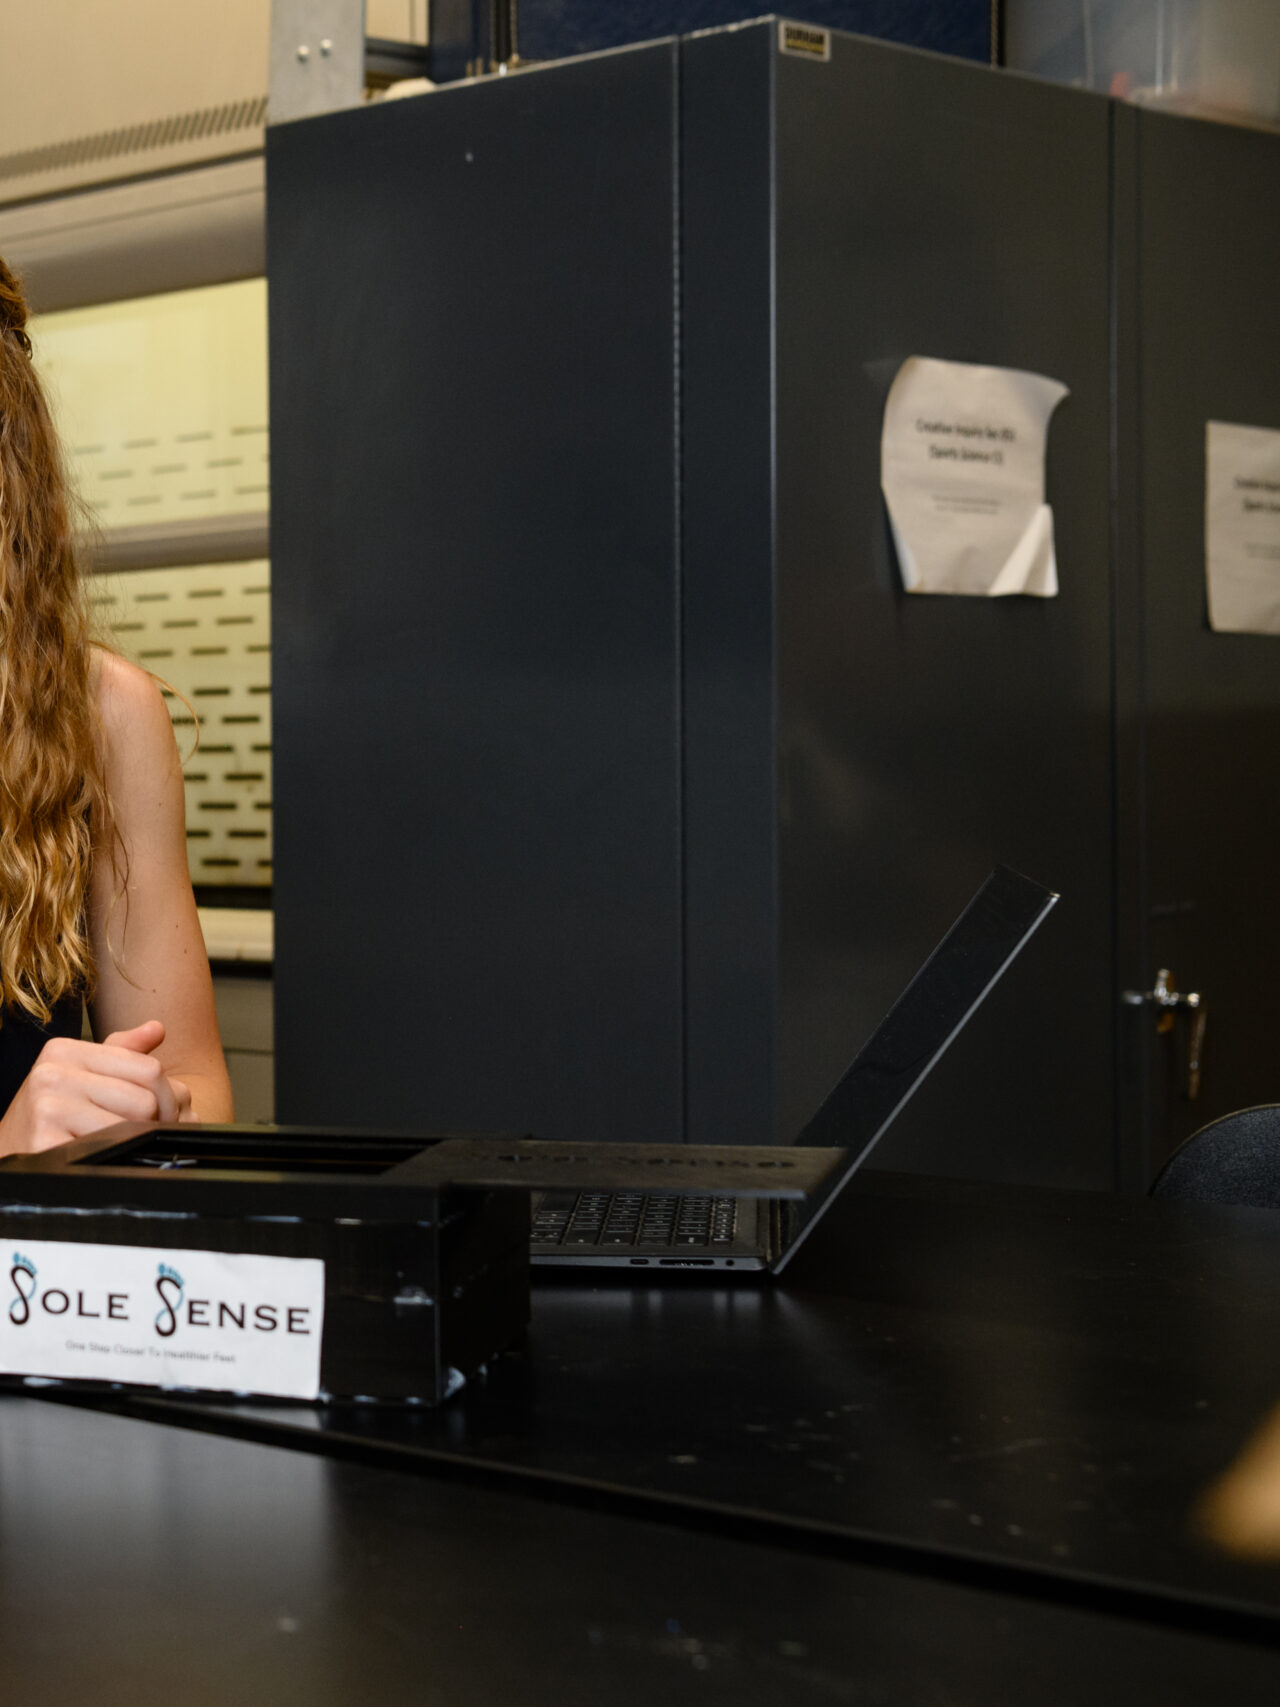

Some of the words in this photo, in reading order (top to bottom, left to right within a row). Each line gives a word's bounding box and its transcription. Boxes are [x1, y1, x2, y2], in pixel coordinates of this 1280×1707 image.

[10, 1253, 130, 1326] SOLE
[155, 1262, 311, 1338] SENSE
[65, 1339, 86, 1352] One
[88, 1341, 111, 1354] Step
[113, 1343, 145, 1357] Closer
[148, 1346, 161, 1358] To
[163, 1348, 210, 1362] Healthier
[213, 1350, 237, 1364] Feet
